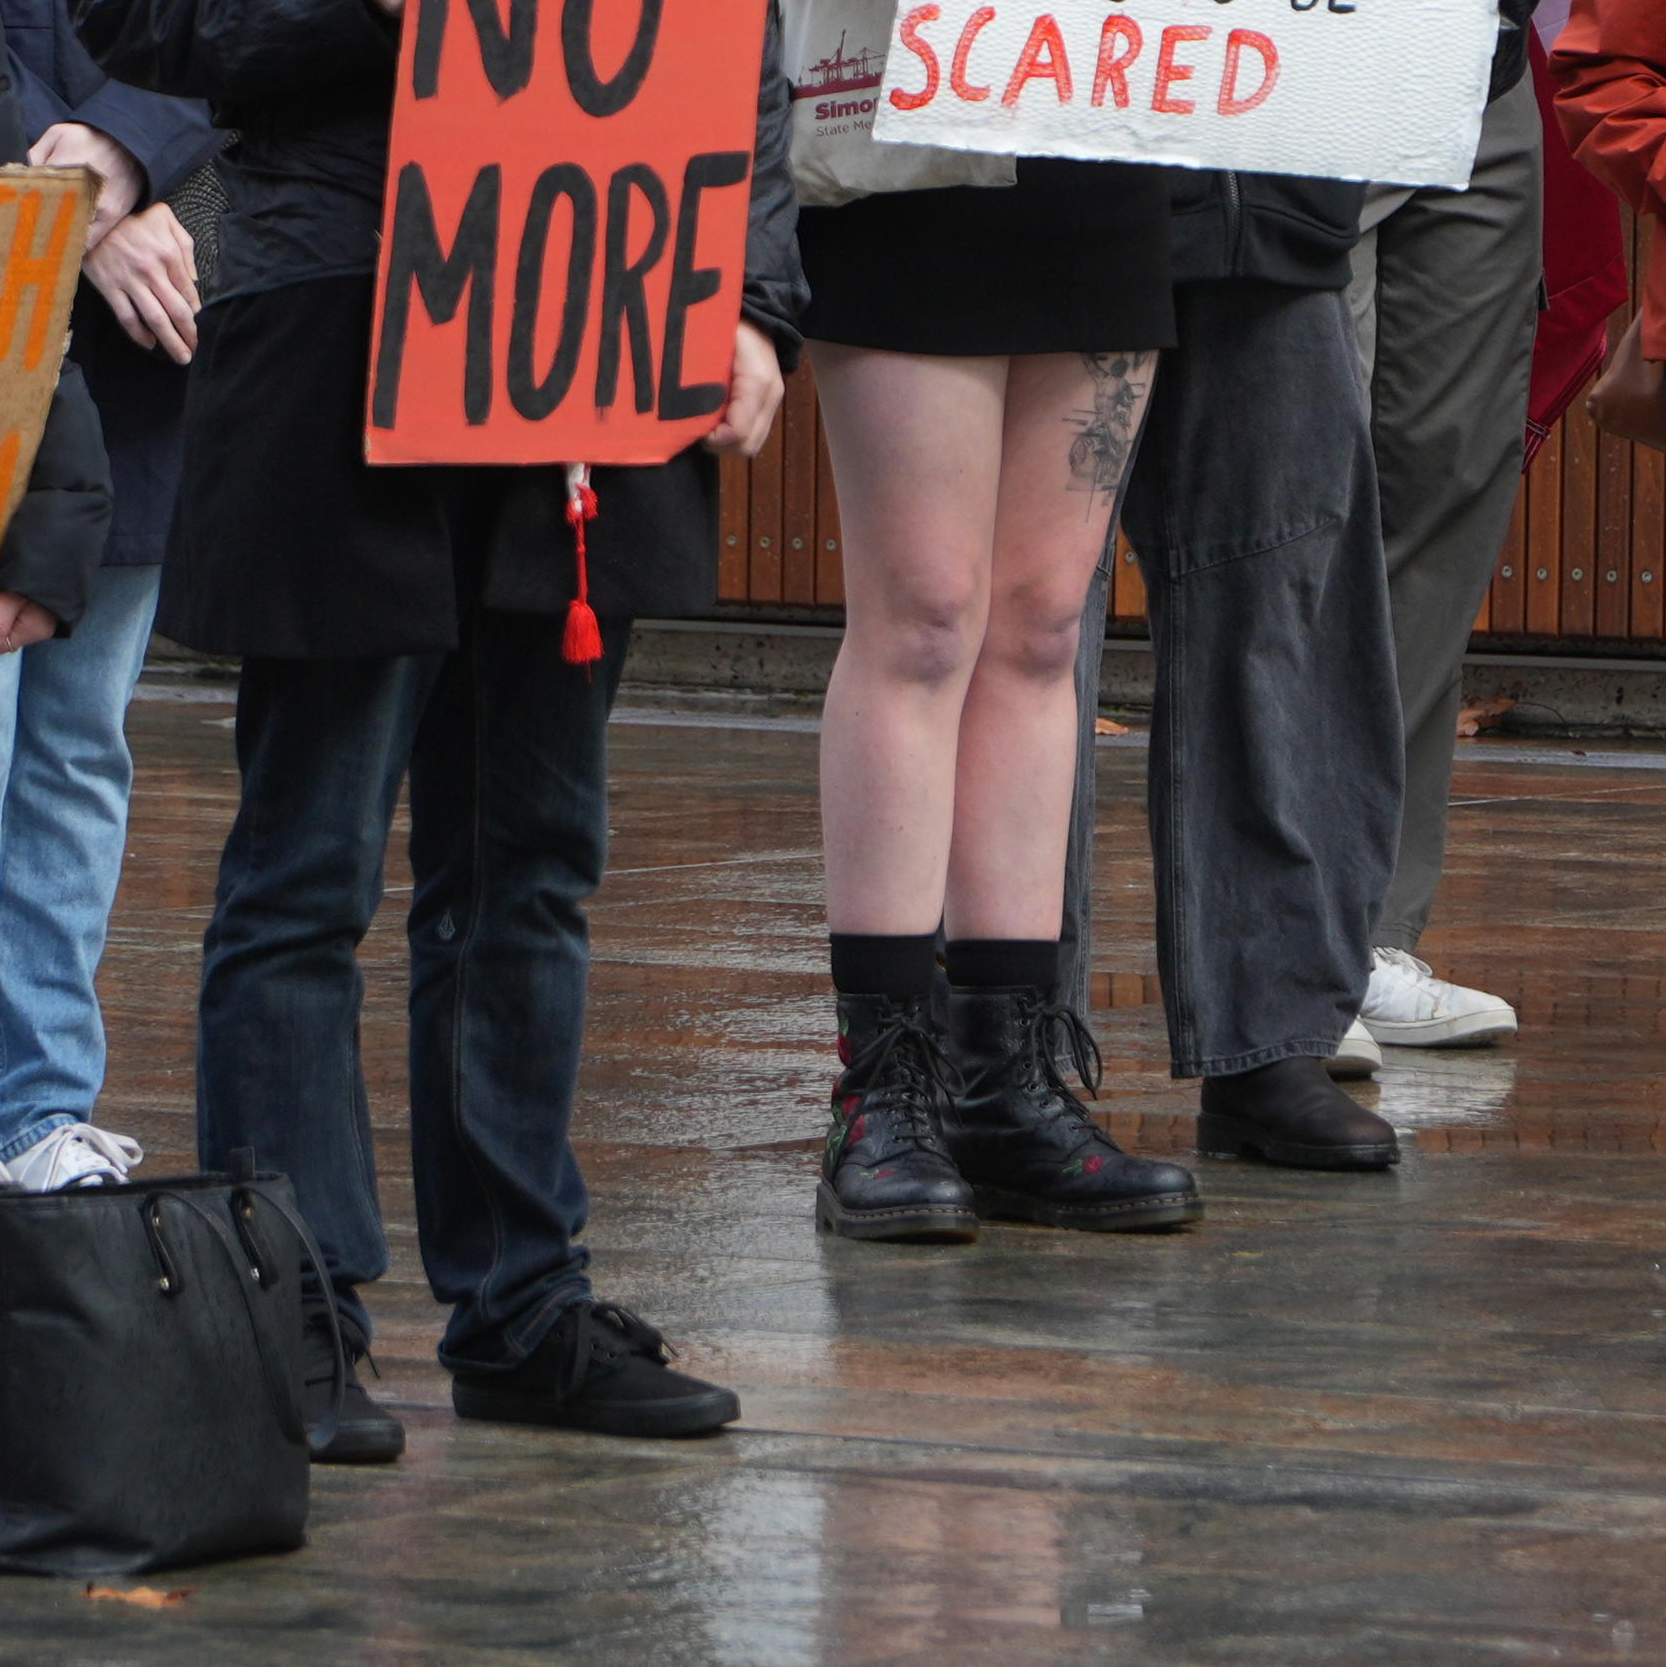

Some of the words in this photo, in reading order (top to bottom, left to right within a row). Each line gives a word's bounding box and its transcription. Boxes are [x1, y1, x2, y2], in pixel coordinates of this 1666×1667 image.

[888, 3, 1281, 117] SCARED
[816, 124, 850, 137] State
[372, 150, 751, 429] MORE
